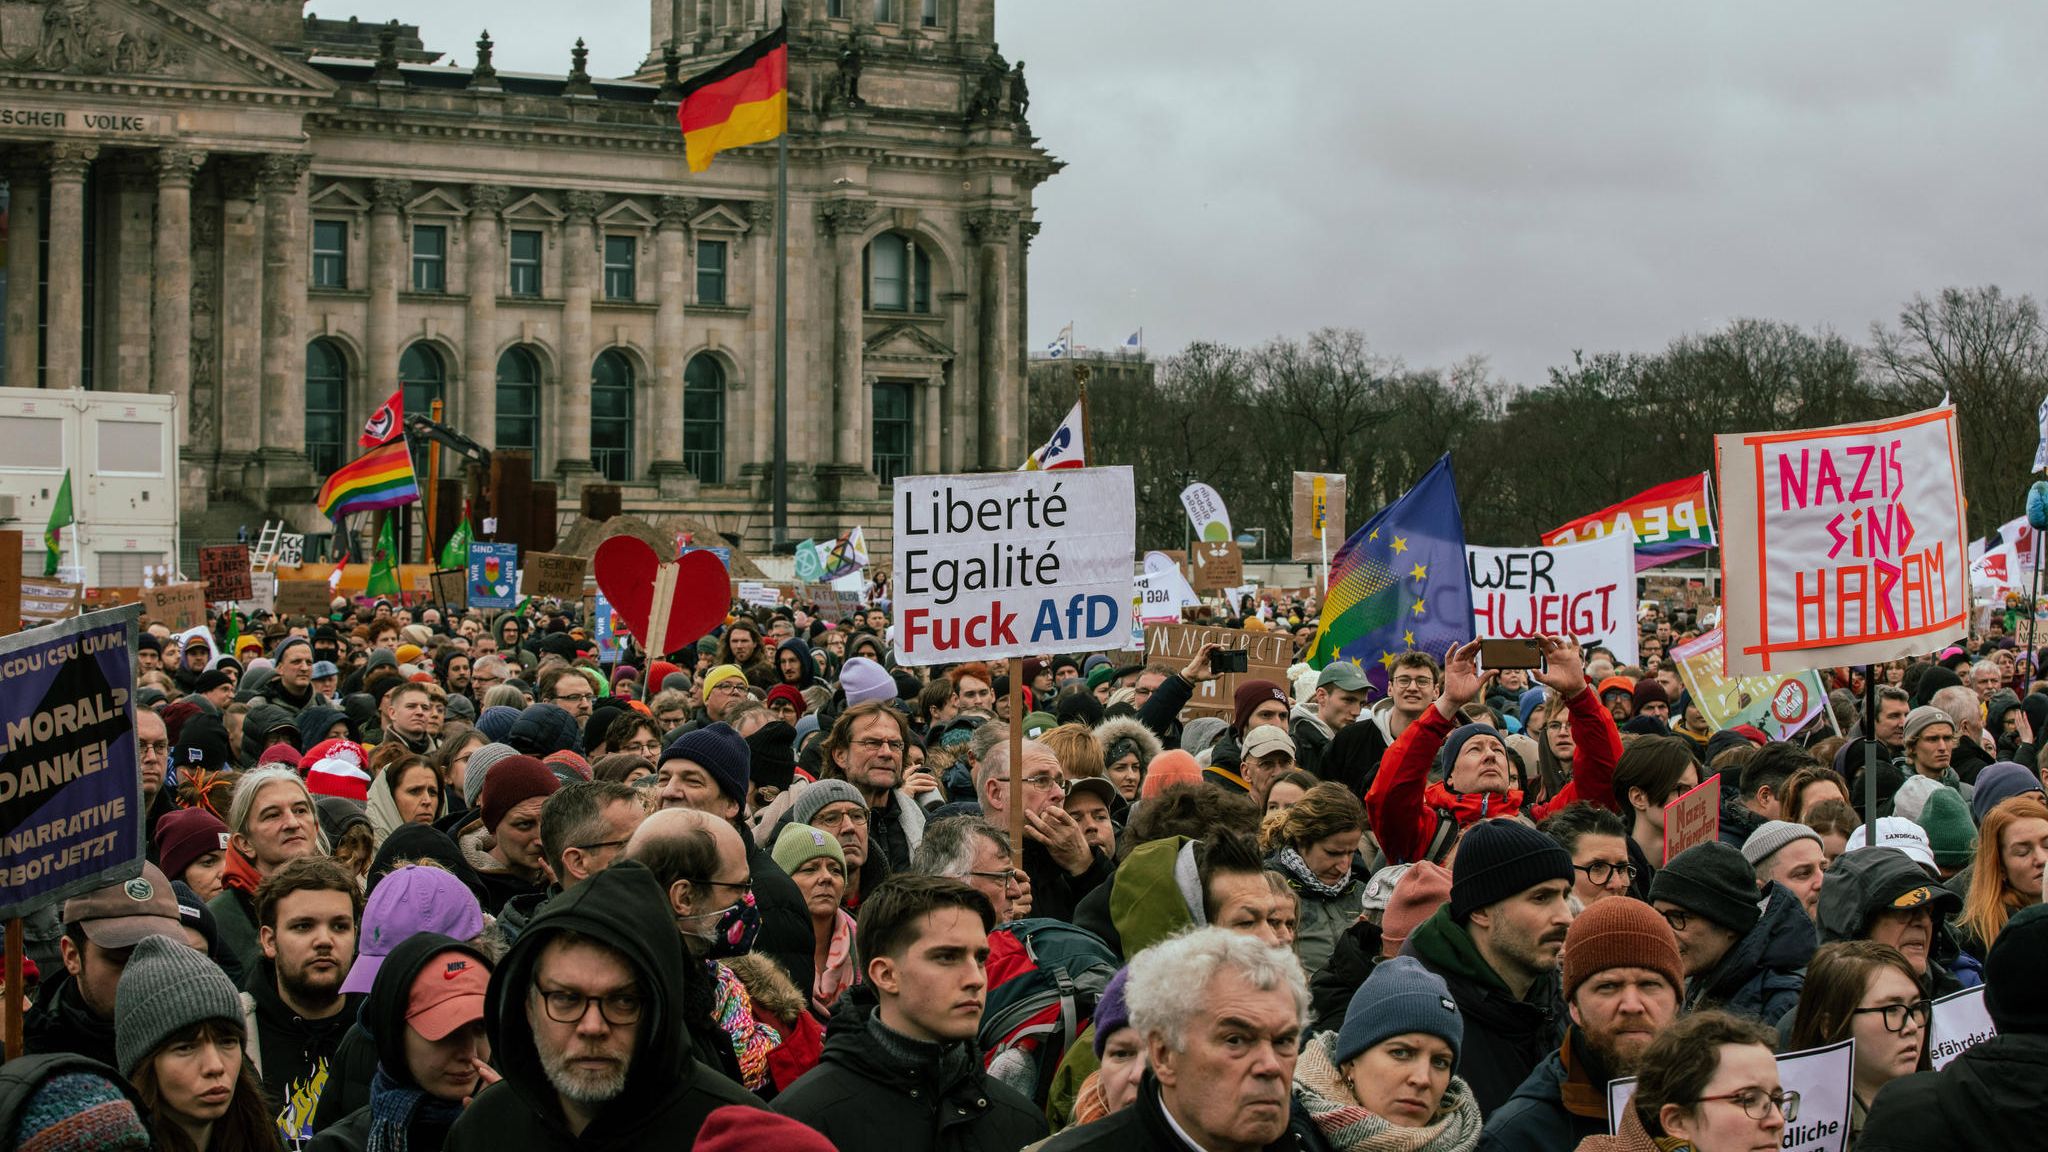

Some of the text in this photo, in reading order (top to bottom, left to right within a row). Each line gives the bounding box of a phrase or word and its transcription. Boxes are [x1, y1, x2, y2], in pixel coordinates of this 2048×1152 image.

[0, 109, 145, 131] SCHEN VOLKE
[1778, 440, 1904, 511] NAZIS
[905, 483, 1067, 536] Liberté
[281, 536, 304, 549] FCK
[472, 545, 494, 554] SIND
[471, 564, 479, 581] WIR
[505, 561, 514, 584] BUNT
[905, 541, 1060, 605] Egalité
[1469, 550, 1555, 594] WER
[1795, 541, 1947, 641] HARAM
[904, 601, 1020, 653] Fuck
[1029, 594, 1120, 643] AfD
[82, 631, 127, 656] UVM.
[0, 740, 109, 804] DANKE!
[1677, 797, 1706, 834] Nazis
[447, 961, 468, 973] NIKE
[1931, 1031, 1987, 1060] efährdet
[1782, 1120, 1839, 1150] dliche
